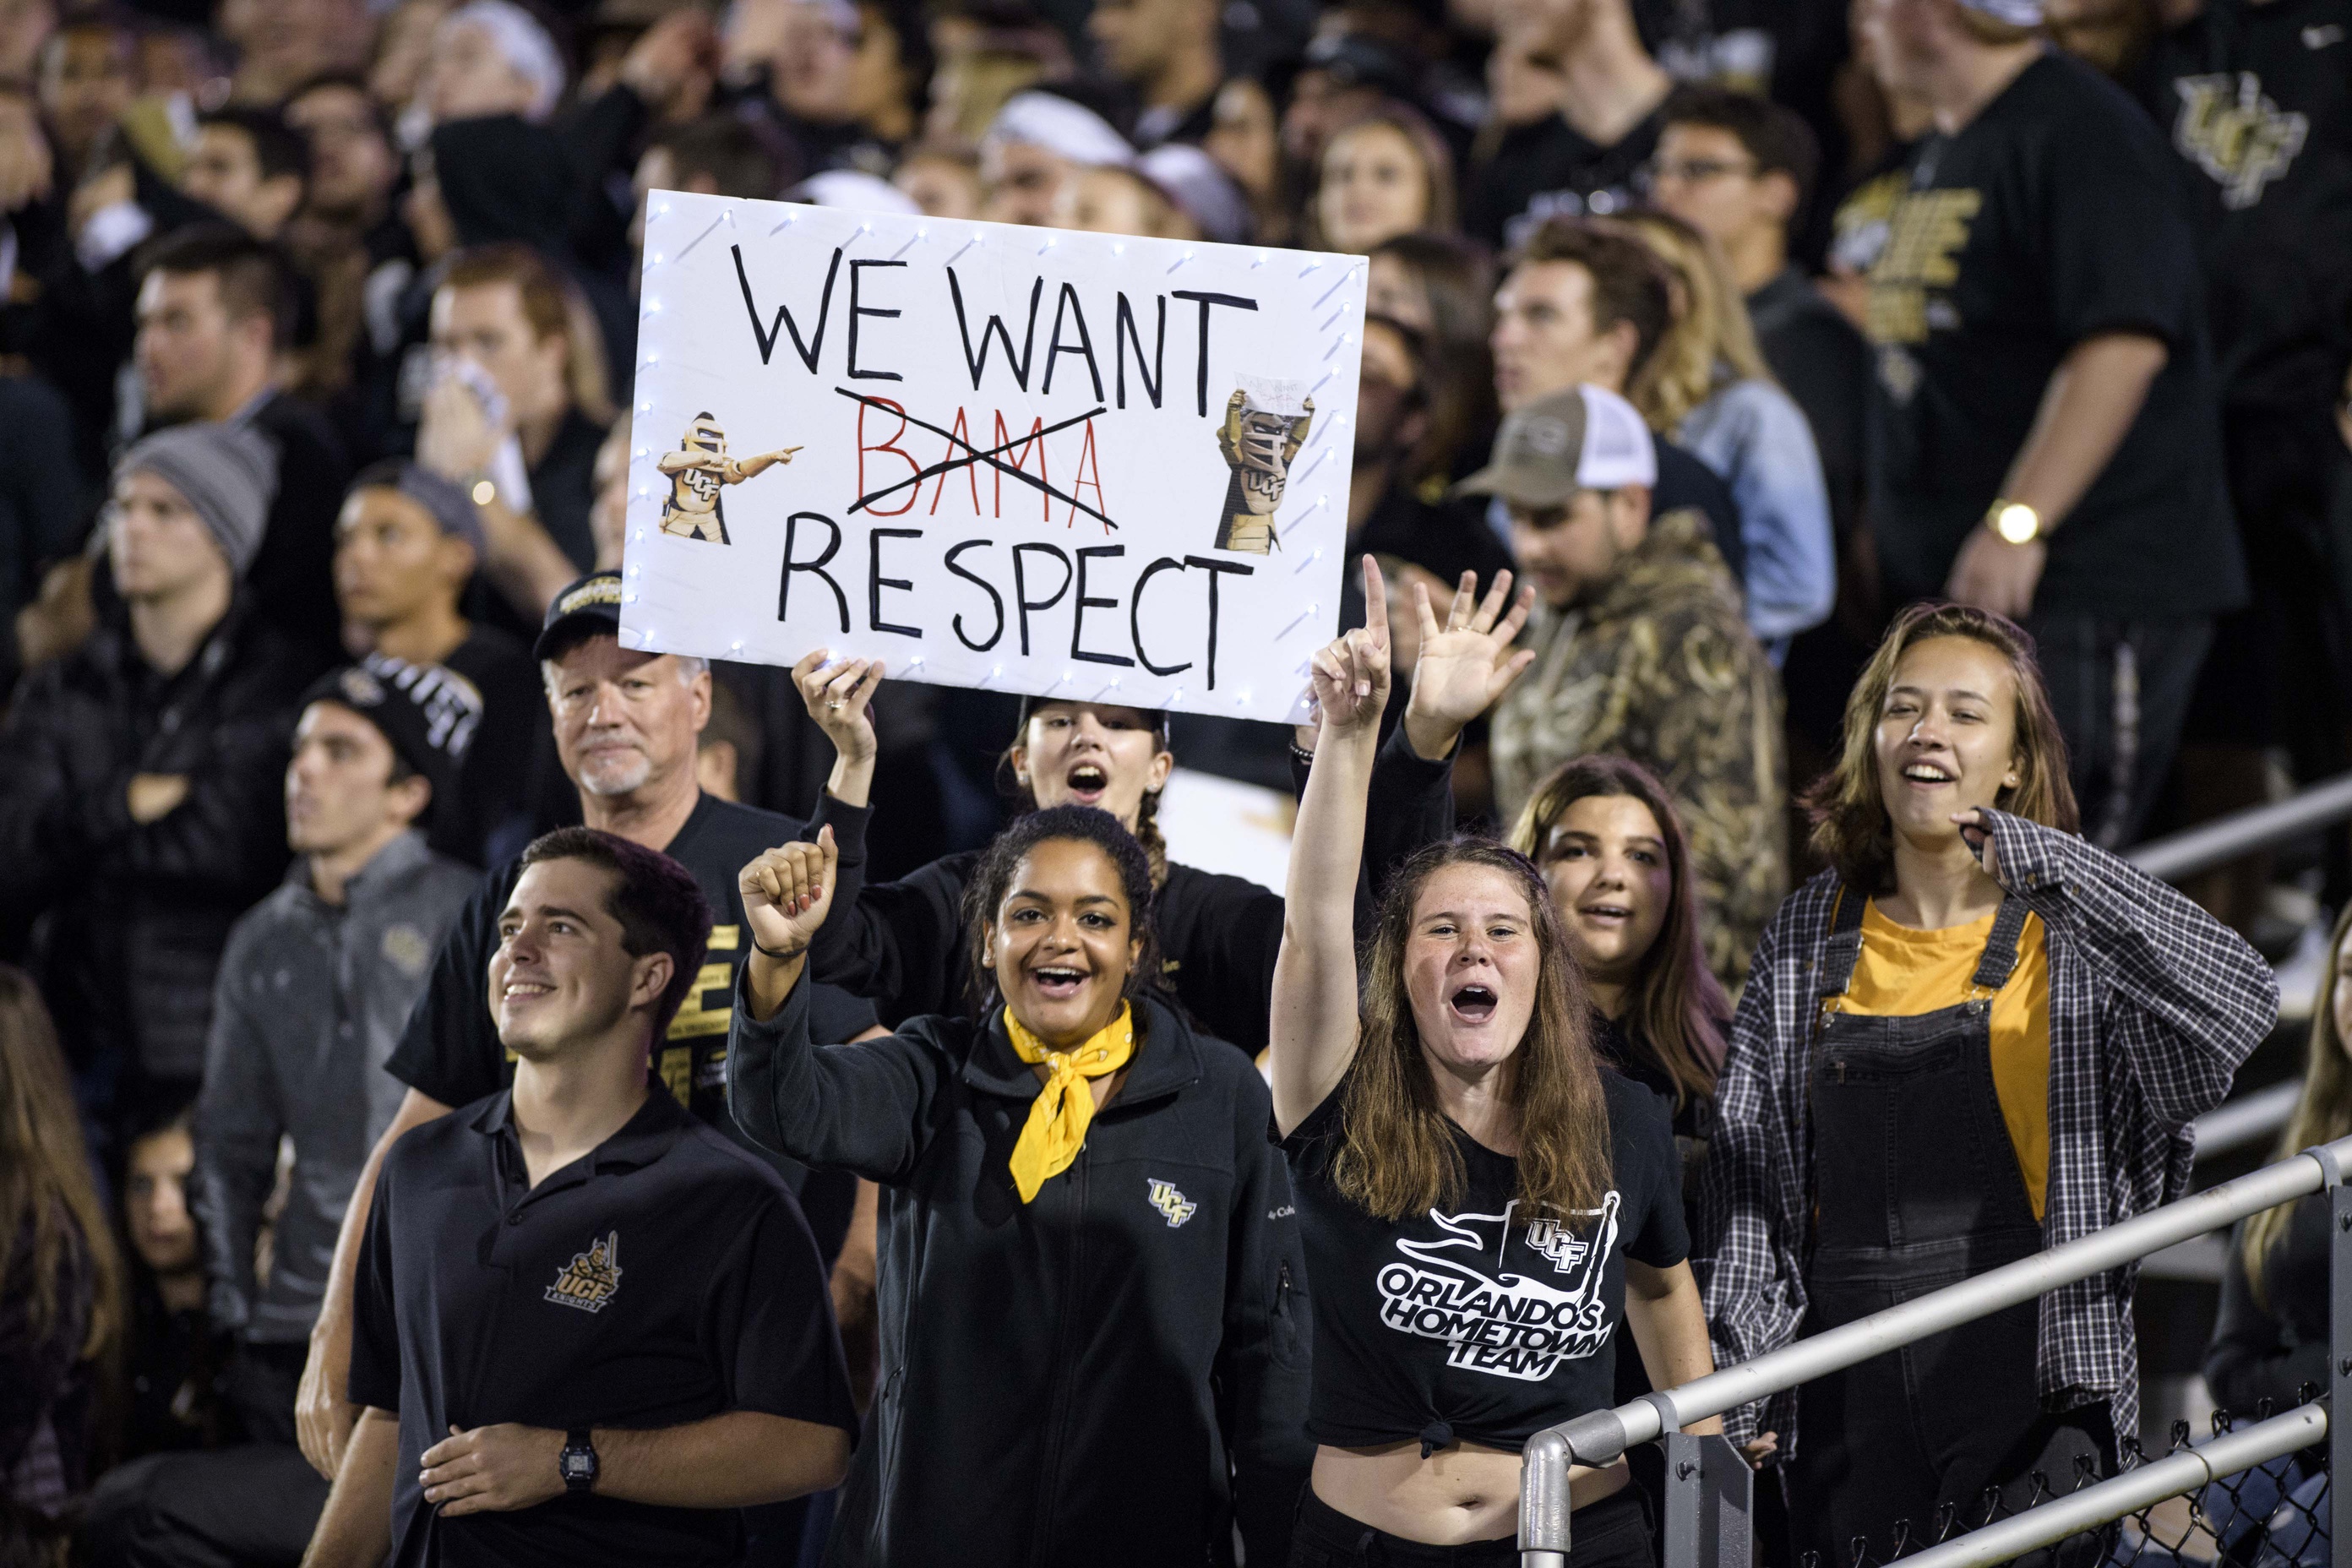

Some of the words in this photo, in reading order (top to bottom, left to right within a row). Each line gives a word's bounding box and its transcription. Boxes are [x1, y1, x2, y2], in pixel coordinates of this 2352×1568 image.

[731, 244, 907, 382] WE
[946, 266, 1259, 417] WANT
[683, 467, 720, 503] UCF
[858, 395, 1113, 536] BAMA
[1248, 471, 1286, 502] UCF
[777, 511, 1255, 691] RESPECT
[1147, 1178, 1197, 1228] UCF
[1525, 1217, 1589, 1274] UCF
[558, 1273, 612, 1301] UCF
[1385, 1298, 1608, 1355] HOMETOWN
[1449, 1340, 1559, 1375] TEAM
